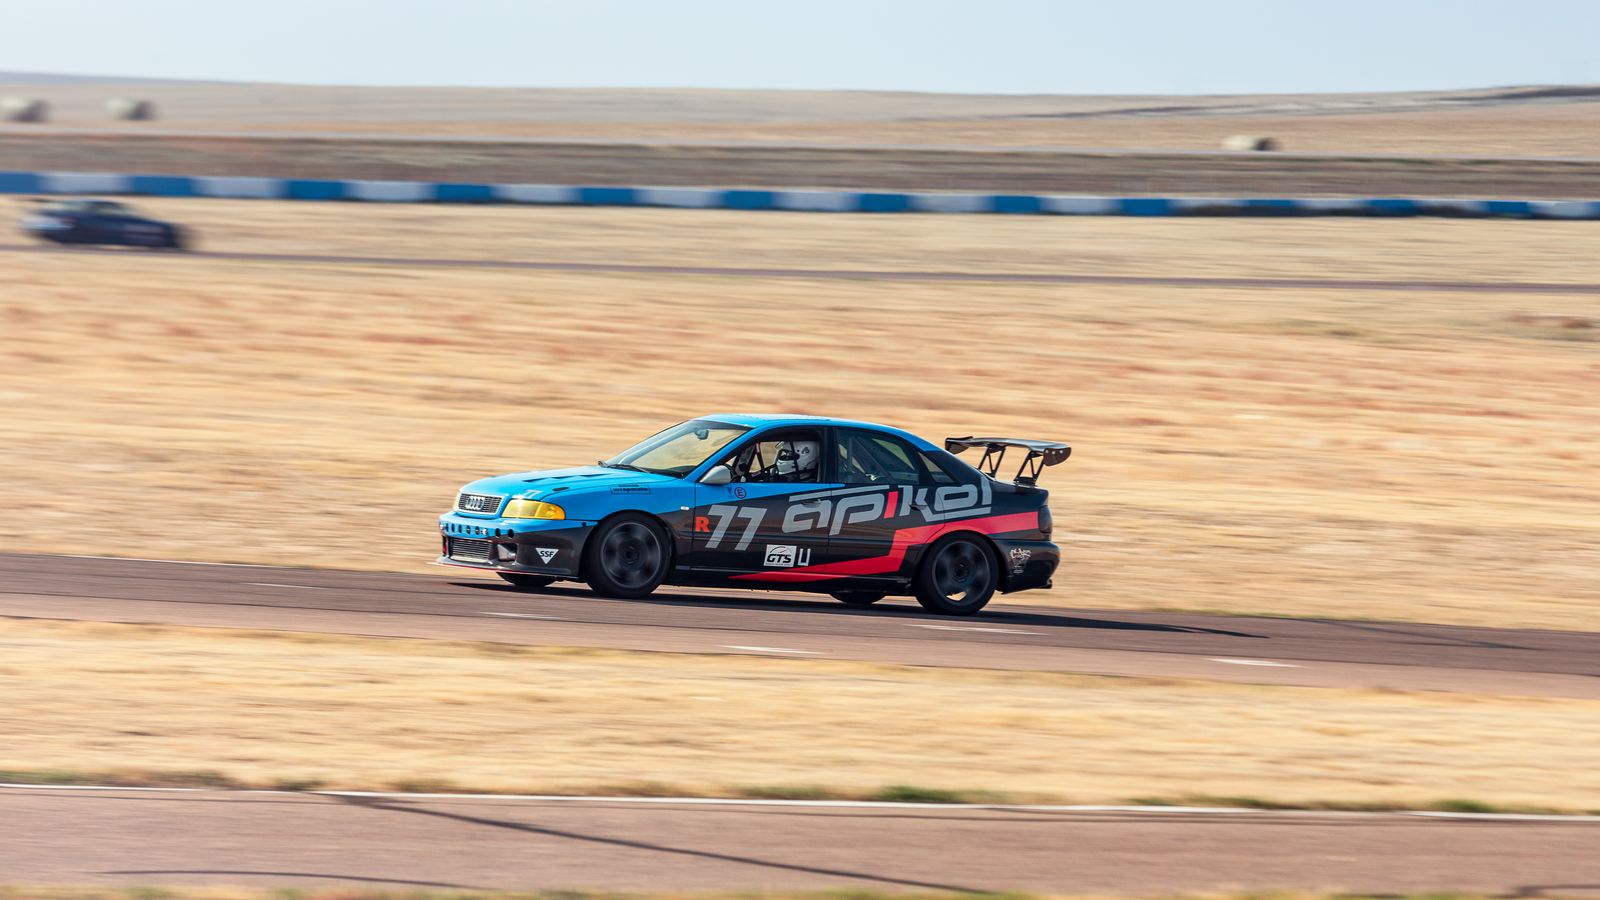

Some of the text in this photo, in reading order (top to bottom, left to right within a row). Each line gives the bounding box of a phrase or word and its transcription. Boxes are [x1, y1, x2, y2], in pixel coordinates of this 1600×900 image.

[695, 504, 768, 551] R 77
[540, 550, 555, 558] SSF
[766, 553, 792, 564] GTS
